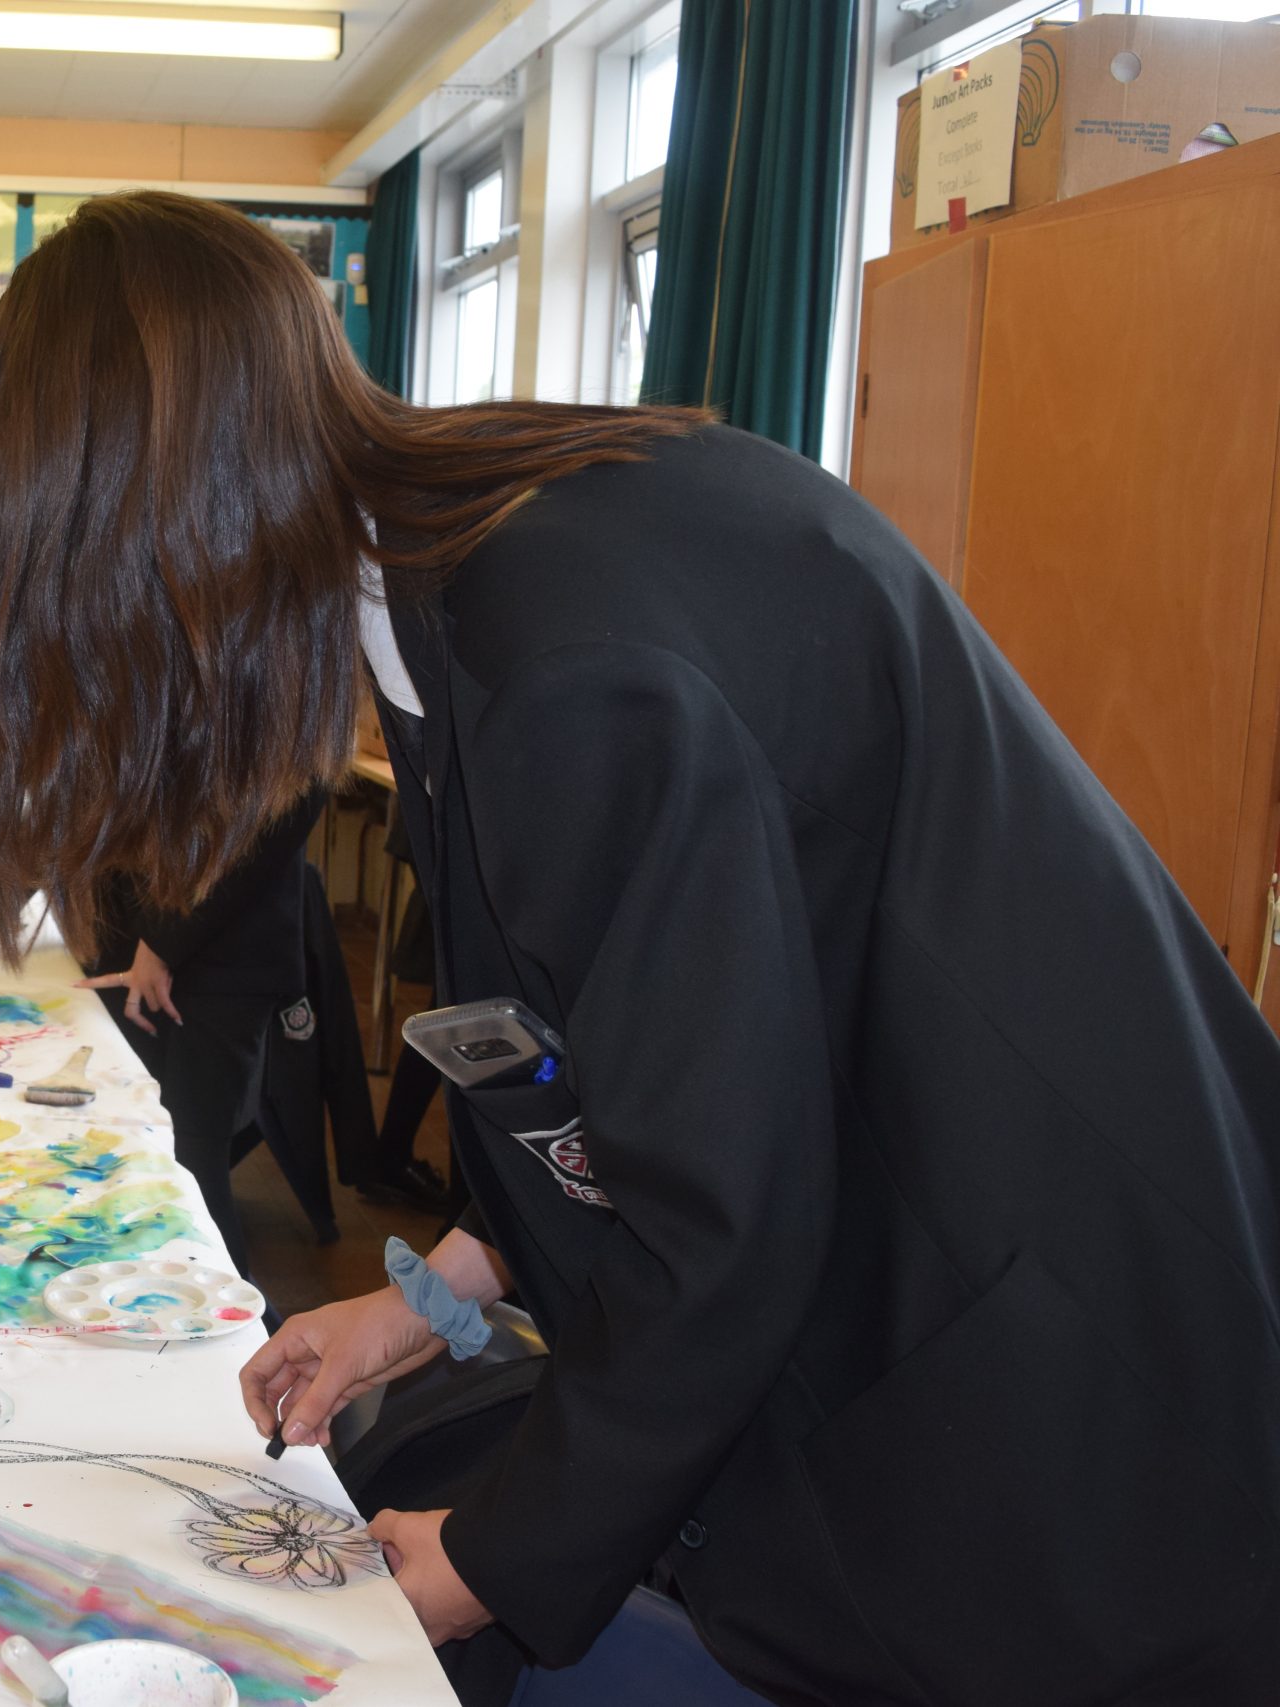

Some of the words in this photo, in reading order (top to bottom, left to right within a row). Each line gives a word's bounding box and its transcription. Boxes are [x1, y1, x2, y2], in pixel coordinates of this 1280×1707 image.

[932, 89, 957, 110] Junior
[958, 82, 969, 101] Art
[970, 73, 993, 96] Packs
[945, 111, 978, 135] Complete
[964, 139, 983, 159] Books
